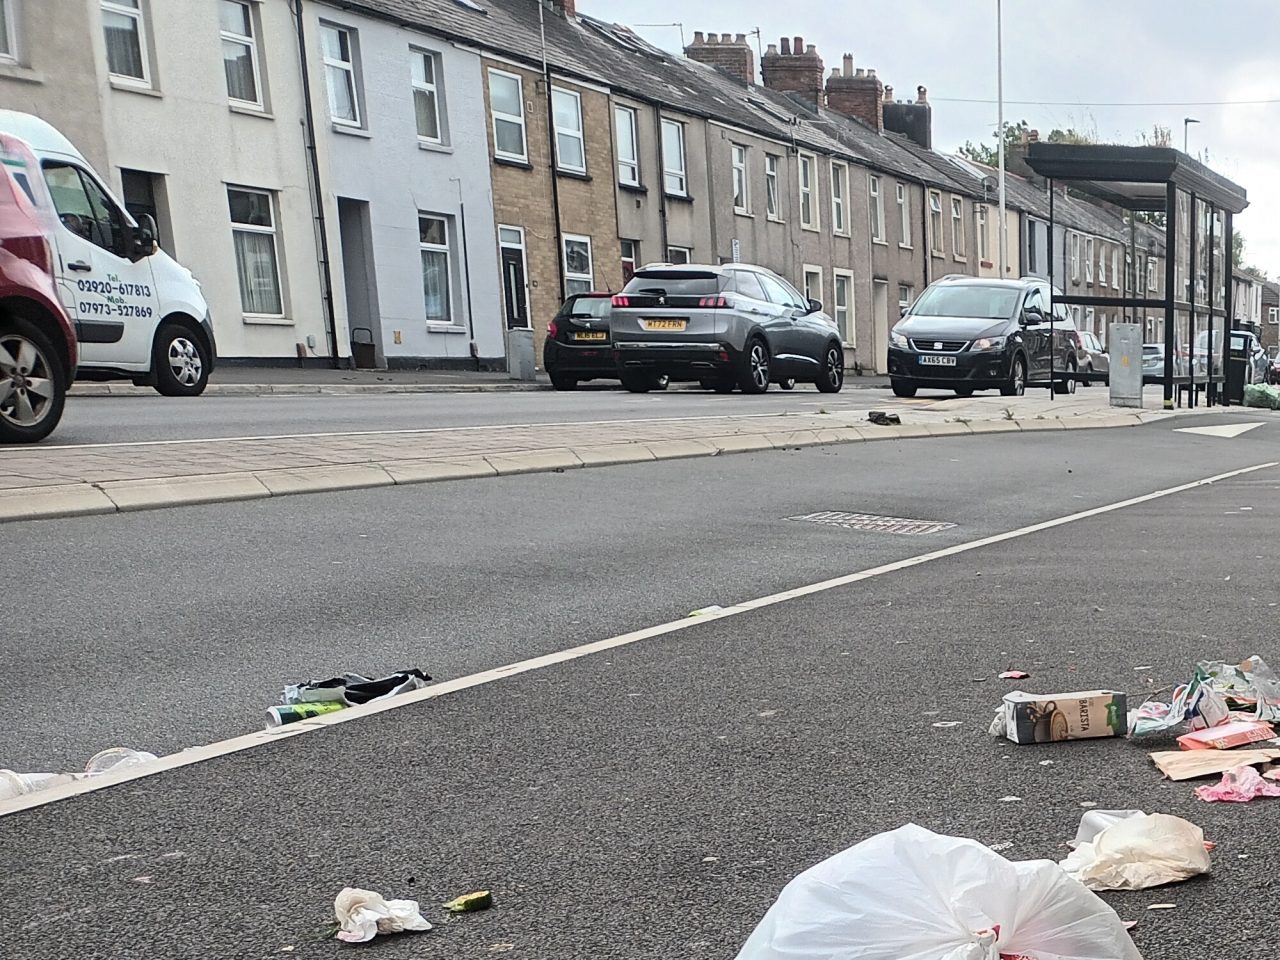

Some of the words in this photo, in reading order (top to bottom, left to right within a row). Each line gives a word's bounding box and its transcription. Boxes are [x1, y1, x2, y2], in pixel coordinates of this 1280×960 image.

[107, 273, 121, 282] Tel.
[78, 280, 151, 297] 02920-617813
[80, 302, 152, 317] 07973-527869
[1078, 699, 1091, 732] BARISTA
